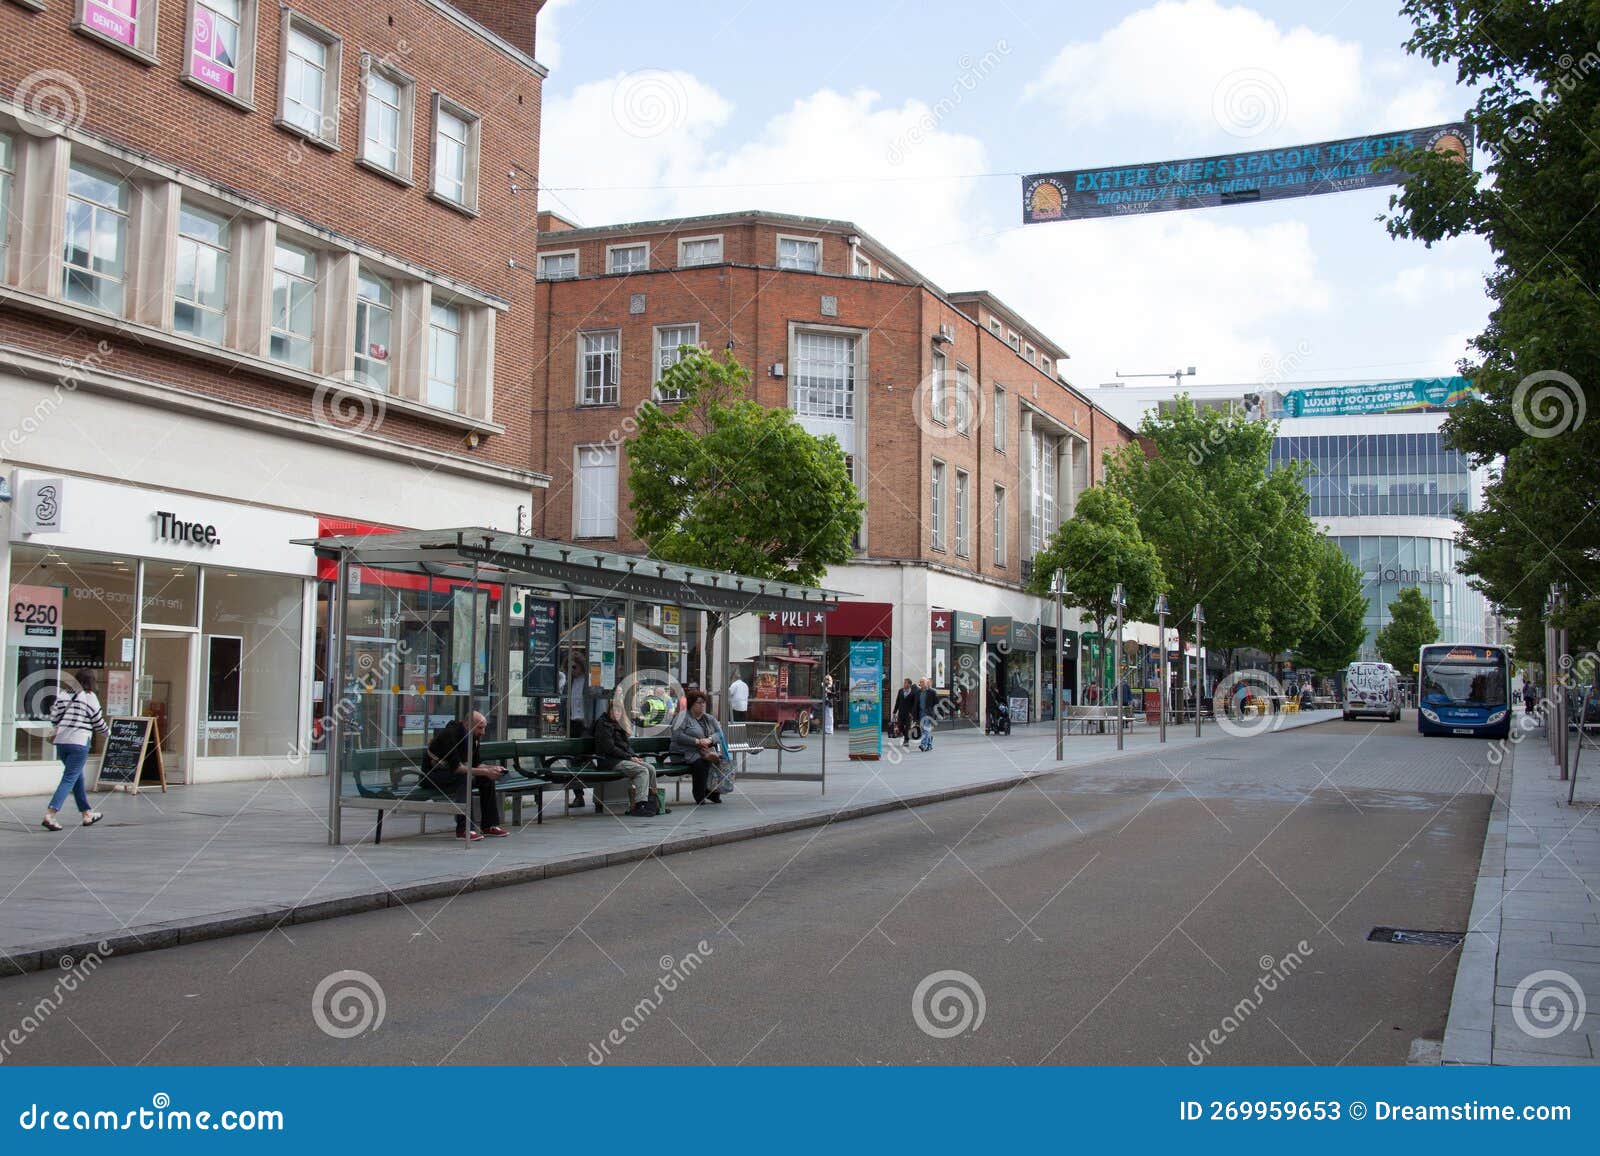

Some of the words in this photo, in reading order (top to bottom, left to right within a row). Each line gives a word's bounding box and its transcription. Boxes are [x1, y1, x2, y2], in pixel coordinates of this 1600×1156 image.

[92, 12, 125, 36] DENTAL
[201, 66, 221, 83] CARE
[1075, 168, 1149, 192] EXETER
[1155, 159, 1228, 185] CHIEFS
[1234, 145, 1321, 176] SEASON
[1328, 133, 1414, 163] TICKETS
[1025, 178, 1046, 211] EXETER
[1049, 178, 1069, 209] RUGBY
[1097, 187, 1166, 205] MONTHLY
[1172, 177, 1263, 198] INSTALMENT
[1268, 171, 1308, 188] PLAN
[1304, 397, 1344, 408] LUXURY
[1393, 391, 1416, 400] SPA
[157, 510, 221, 545] Three.
[1376, 564, 1420, 586] John
[14, 602, 58, 625] £250
